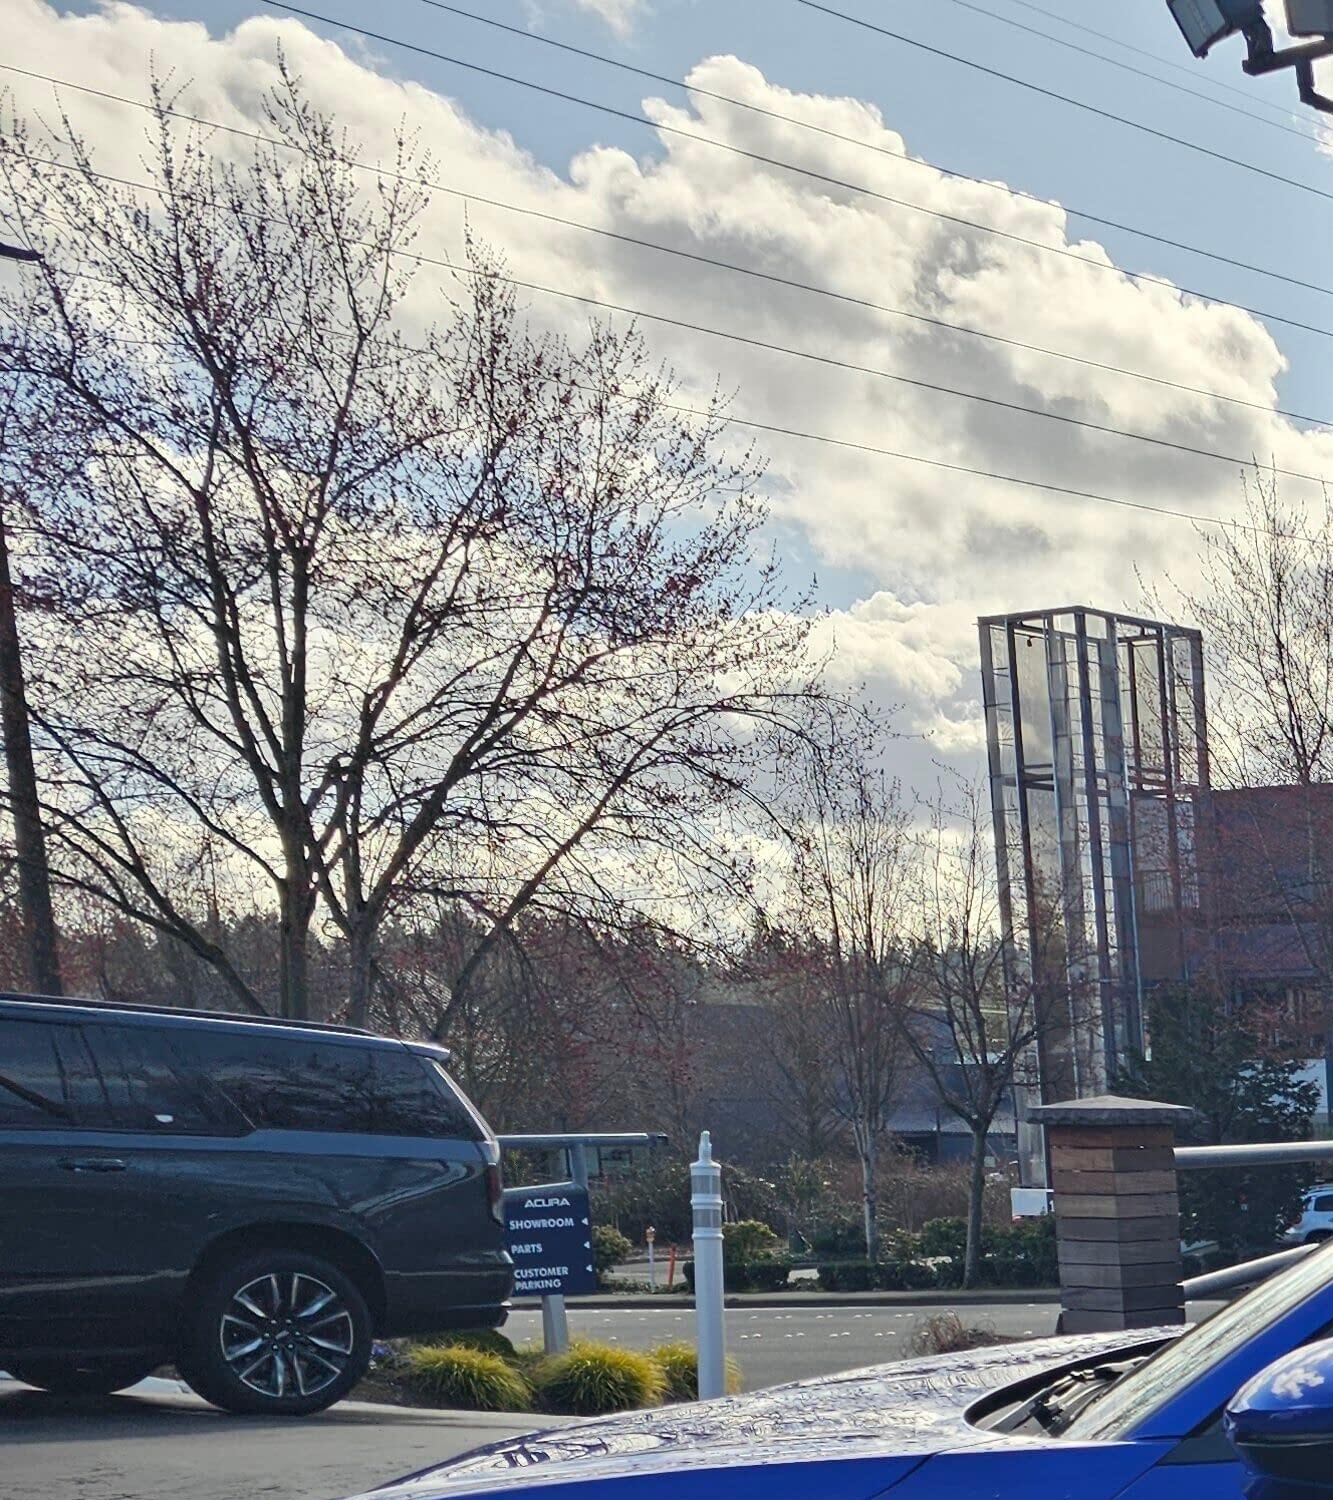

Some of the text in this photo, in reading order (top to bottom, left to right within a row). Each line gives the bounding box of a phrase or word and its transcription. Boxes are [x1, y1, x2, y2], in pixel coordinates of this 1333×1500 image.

[524, 1198, 571, 1208] ACURA
[509, 1218, 574, 1230] SHOWROOM
[511, 1243, 543, 1254] PARTS
[514, 1266, 569, 1279] CUSTOMER
[515, 1279, 562, 1290] PARKING
